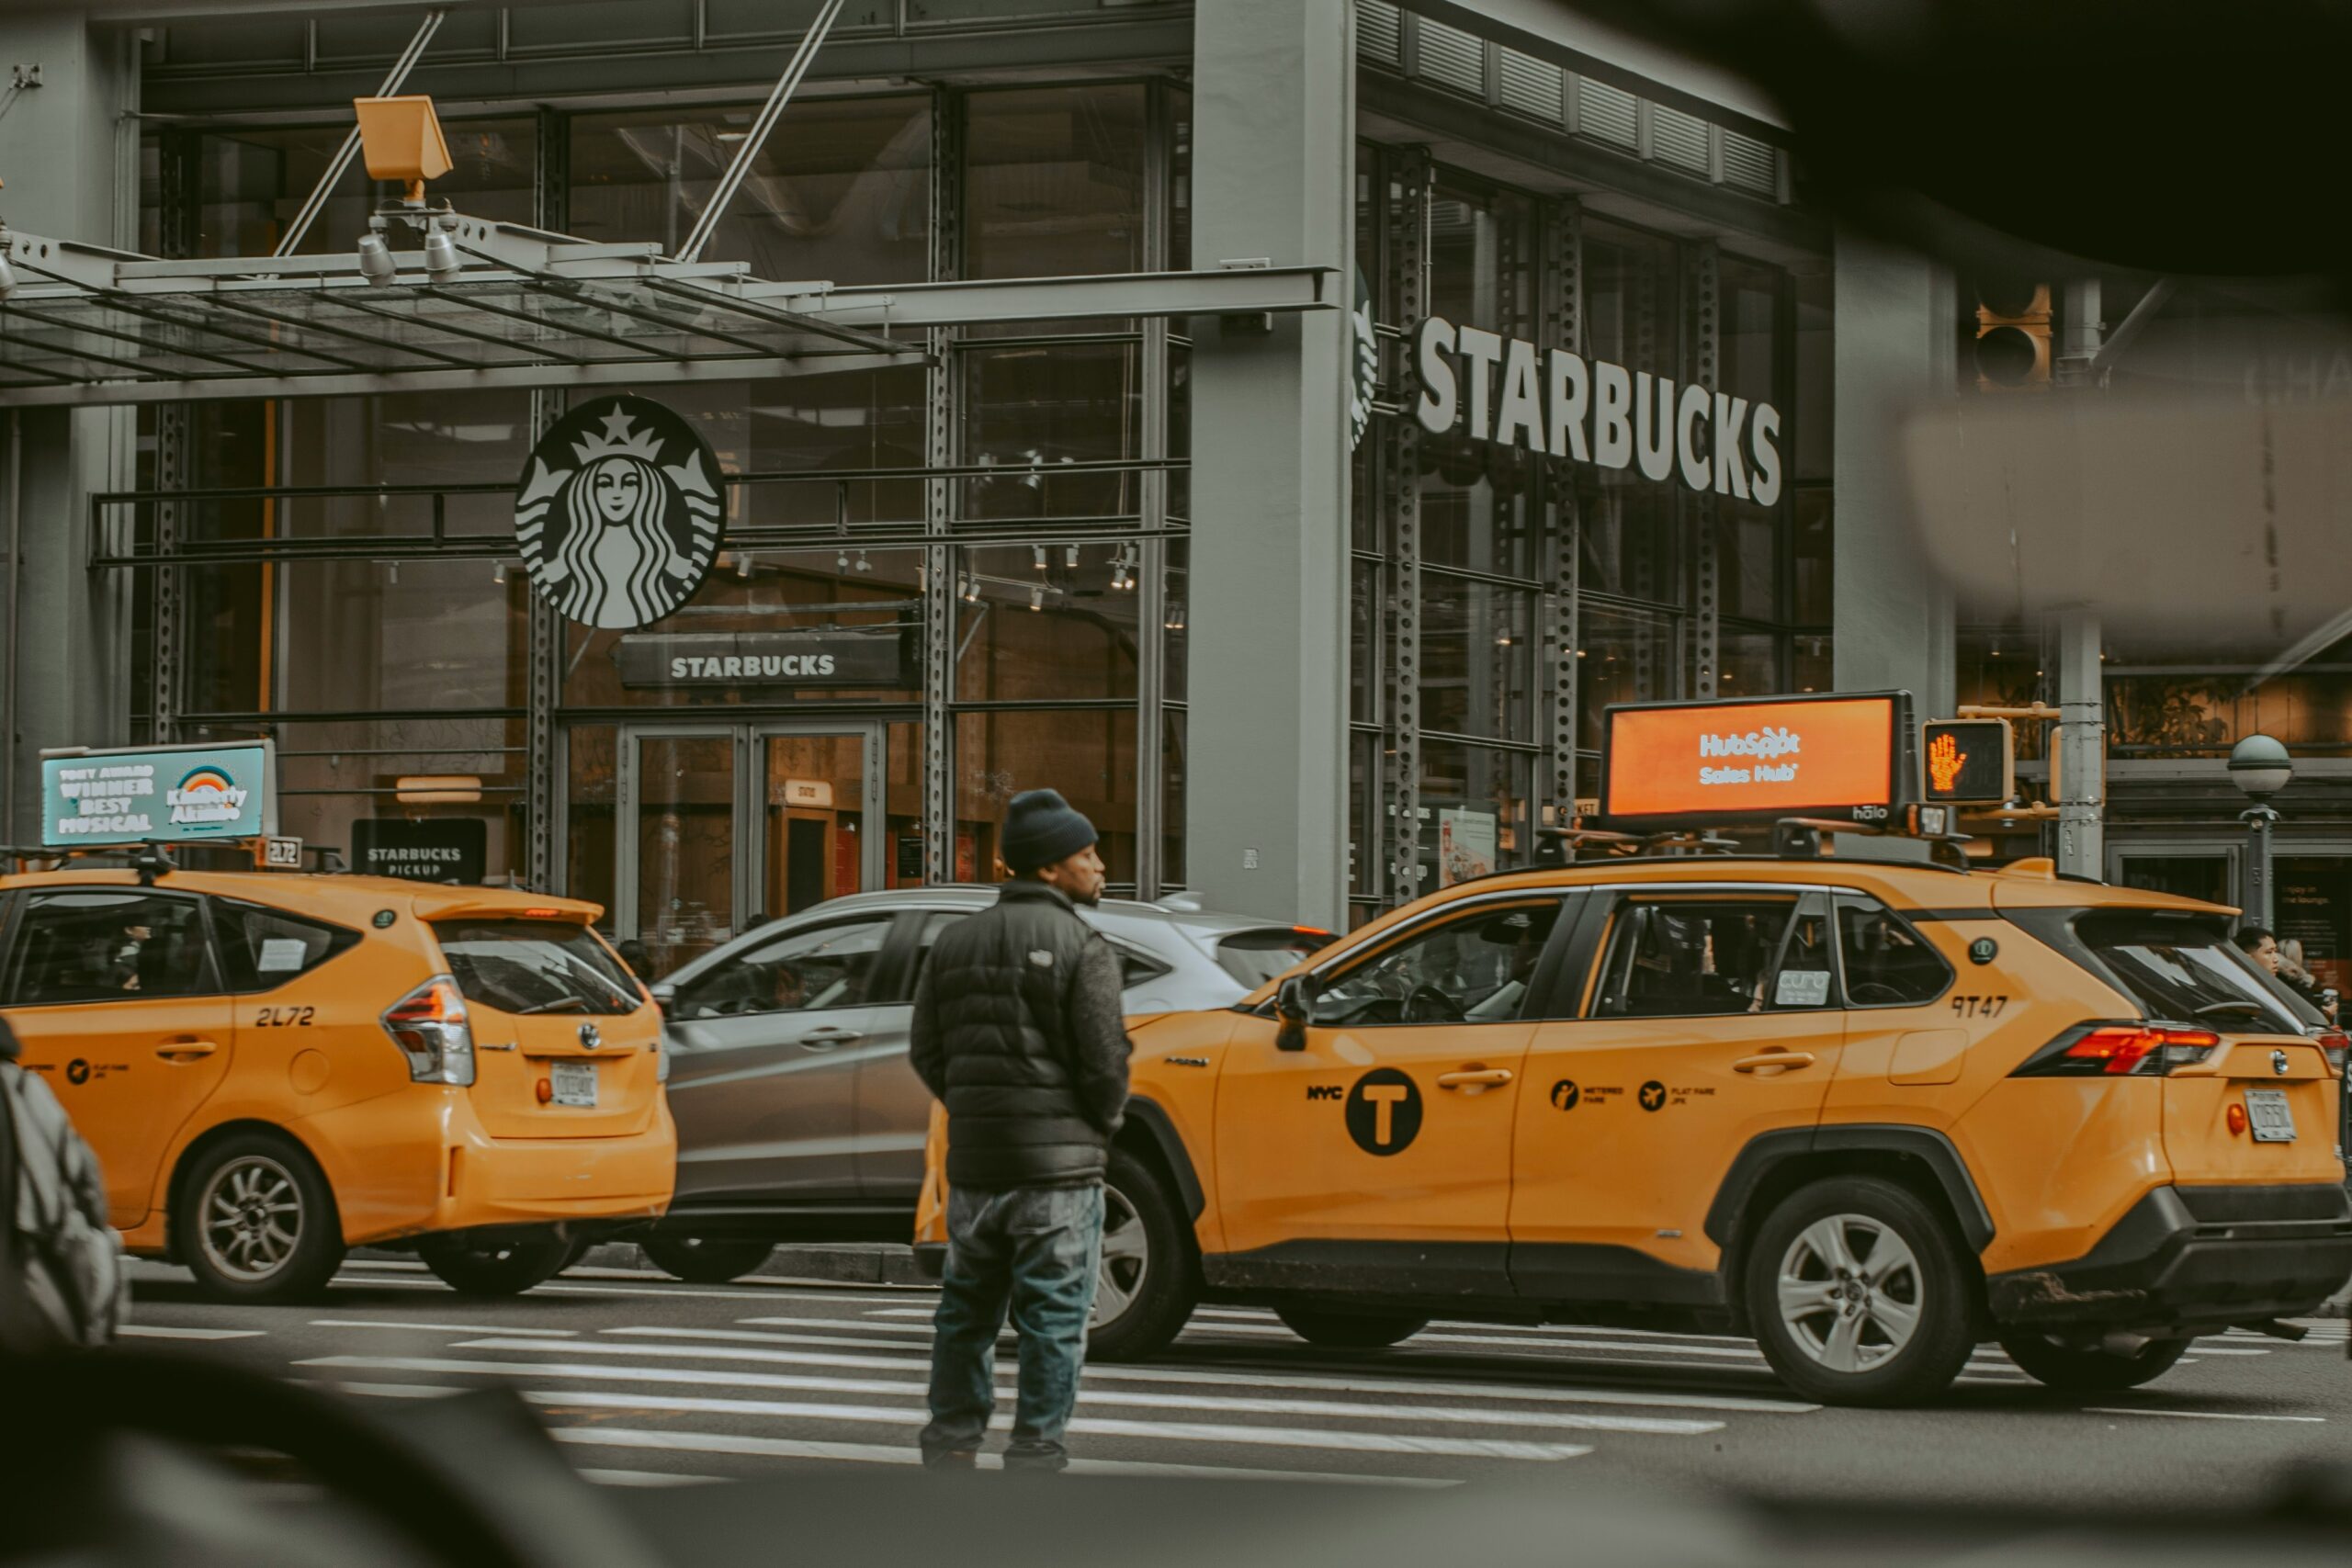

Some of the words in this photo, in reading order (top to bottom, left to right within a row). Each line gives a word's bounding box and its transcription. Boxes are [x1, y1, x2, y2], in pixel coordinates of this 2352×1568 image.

[1413, 316, 1781, 506] STARBUCKS
[671, 655, 835, 678] STARBUCKS
[1700, 727, 1801, 760] HubSpot
[60, 778, 154, 797] WINNER
[80, 797, 131, 816] BEST
[59, 814, 153, 833] MUSICAL
[368, 848, 461, 862] STARBUCKS
[389, 864, 441, 876] PICKUP
[255, 1006, 315, 1027] 2L72
[1952, 996, 2008, 1019] 9T47
[1306, 1086, 1344, 1100] NYC
[1362, 1085, 1408, 1145] T
